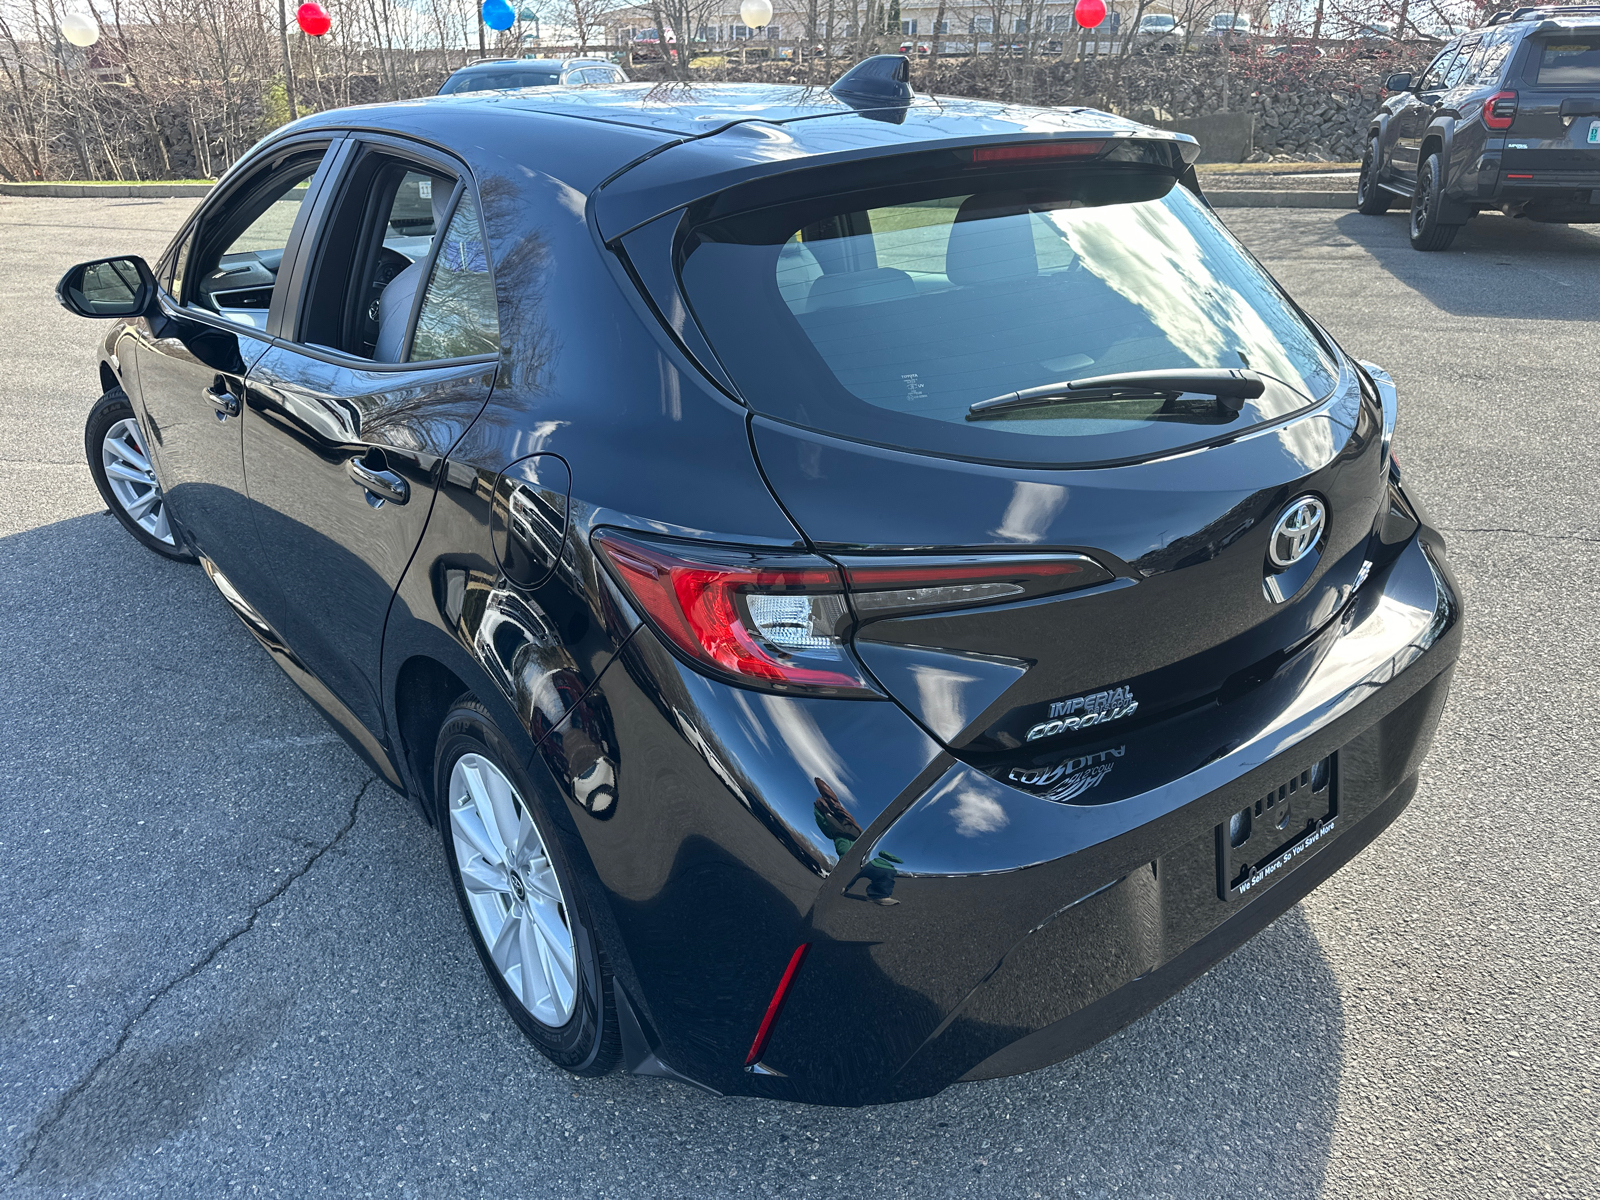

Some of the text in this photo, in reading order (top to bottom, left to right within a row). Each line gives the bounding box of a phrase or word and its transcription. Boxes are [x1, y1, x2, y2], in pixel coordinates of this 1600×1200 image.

[1025, 700, 1139, 742] COROLLA
[1049, 685, 1133, 718] IMPERIAL
[1239, 822, 1335, 894] We Sell More, So You Save More
